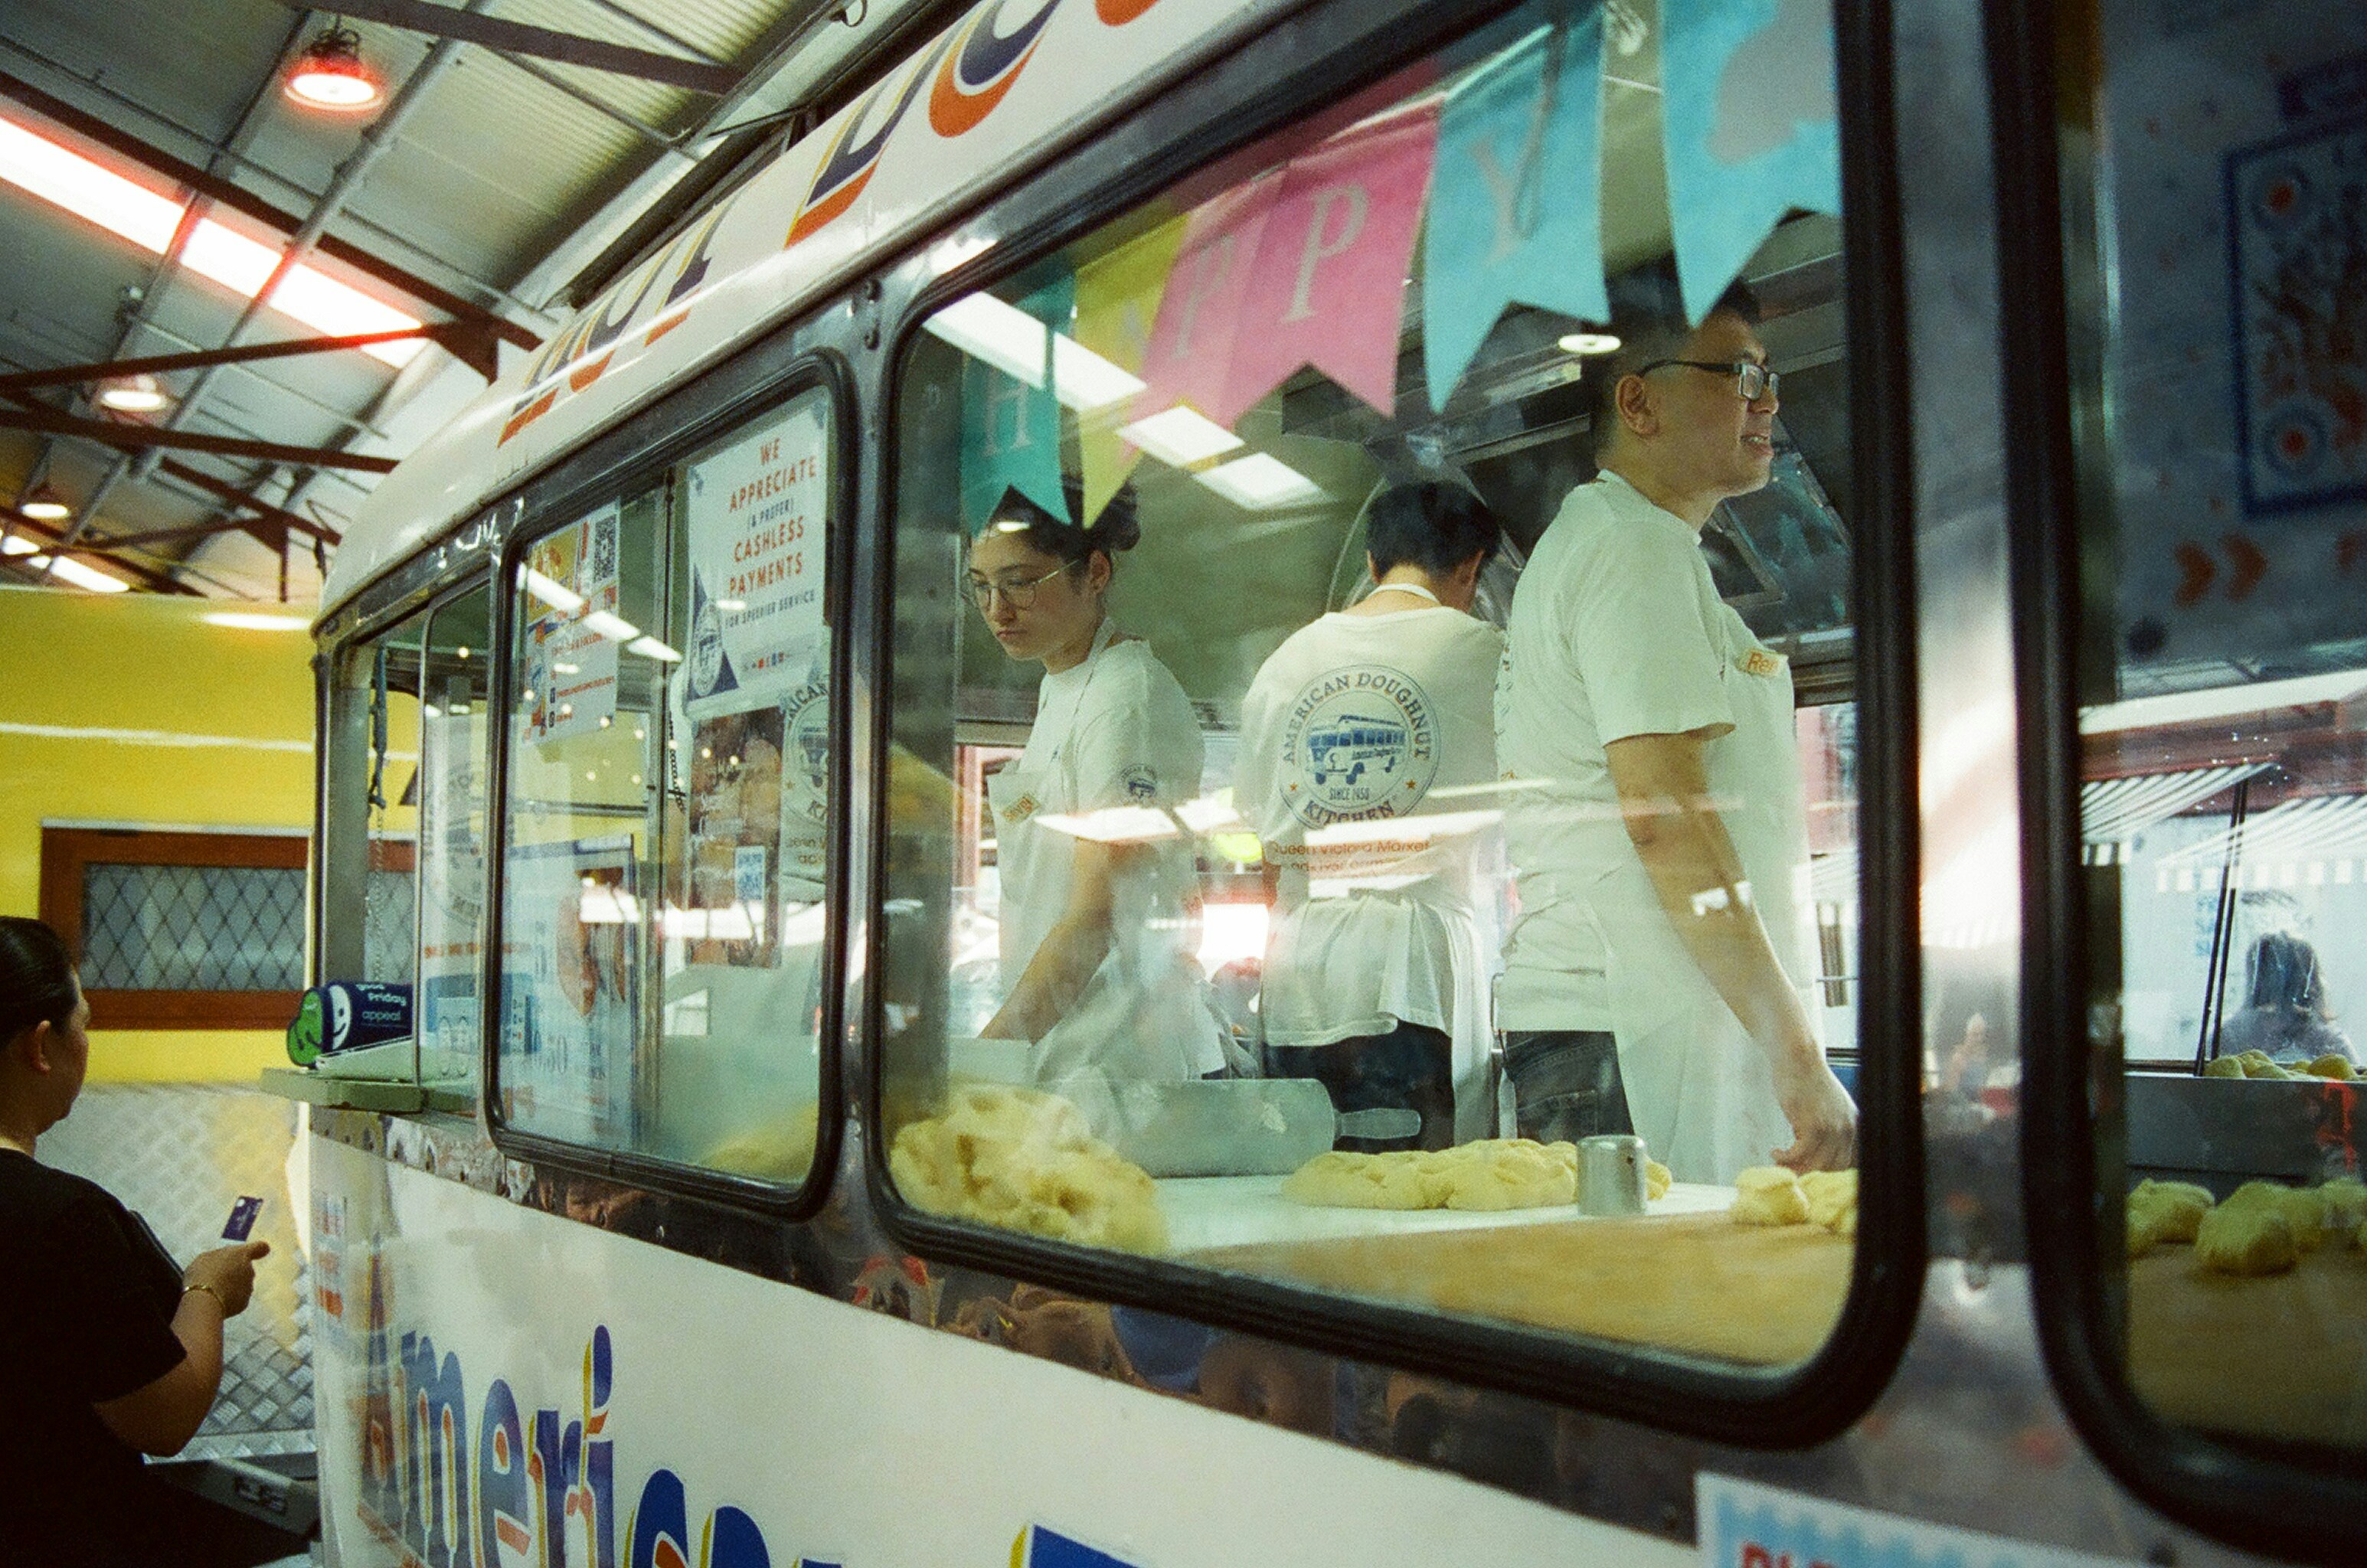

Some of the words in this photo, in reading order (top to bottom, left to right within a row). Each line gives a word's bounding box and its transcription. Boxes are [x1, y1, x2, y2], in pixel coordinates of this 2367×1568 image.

[759, 437, 781, 466] WE
[729, 456, 816, 514] APPRECIATE
[733, 515, 806, 564] CASHLESS
[729, 552, 803, 599] PAYMENTS
[778, 588, 816, 612] SERVICE
[1283, 674, 1350, 766] AMERICAN
[1356, 671, 1432, 761] DOUGHNUT
[1303, 800, 1395, 825] KITCHEN
[1376, 839, 1430, 854] Market
[361, 1010, 401, 1023] appeal
